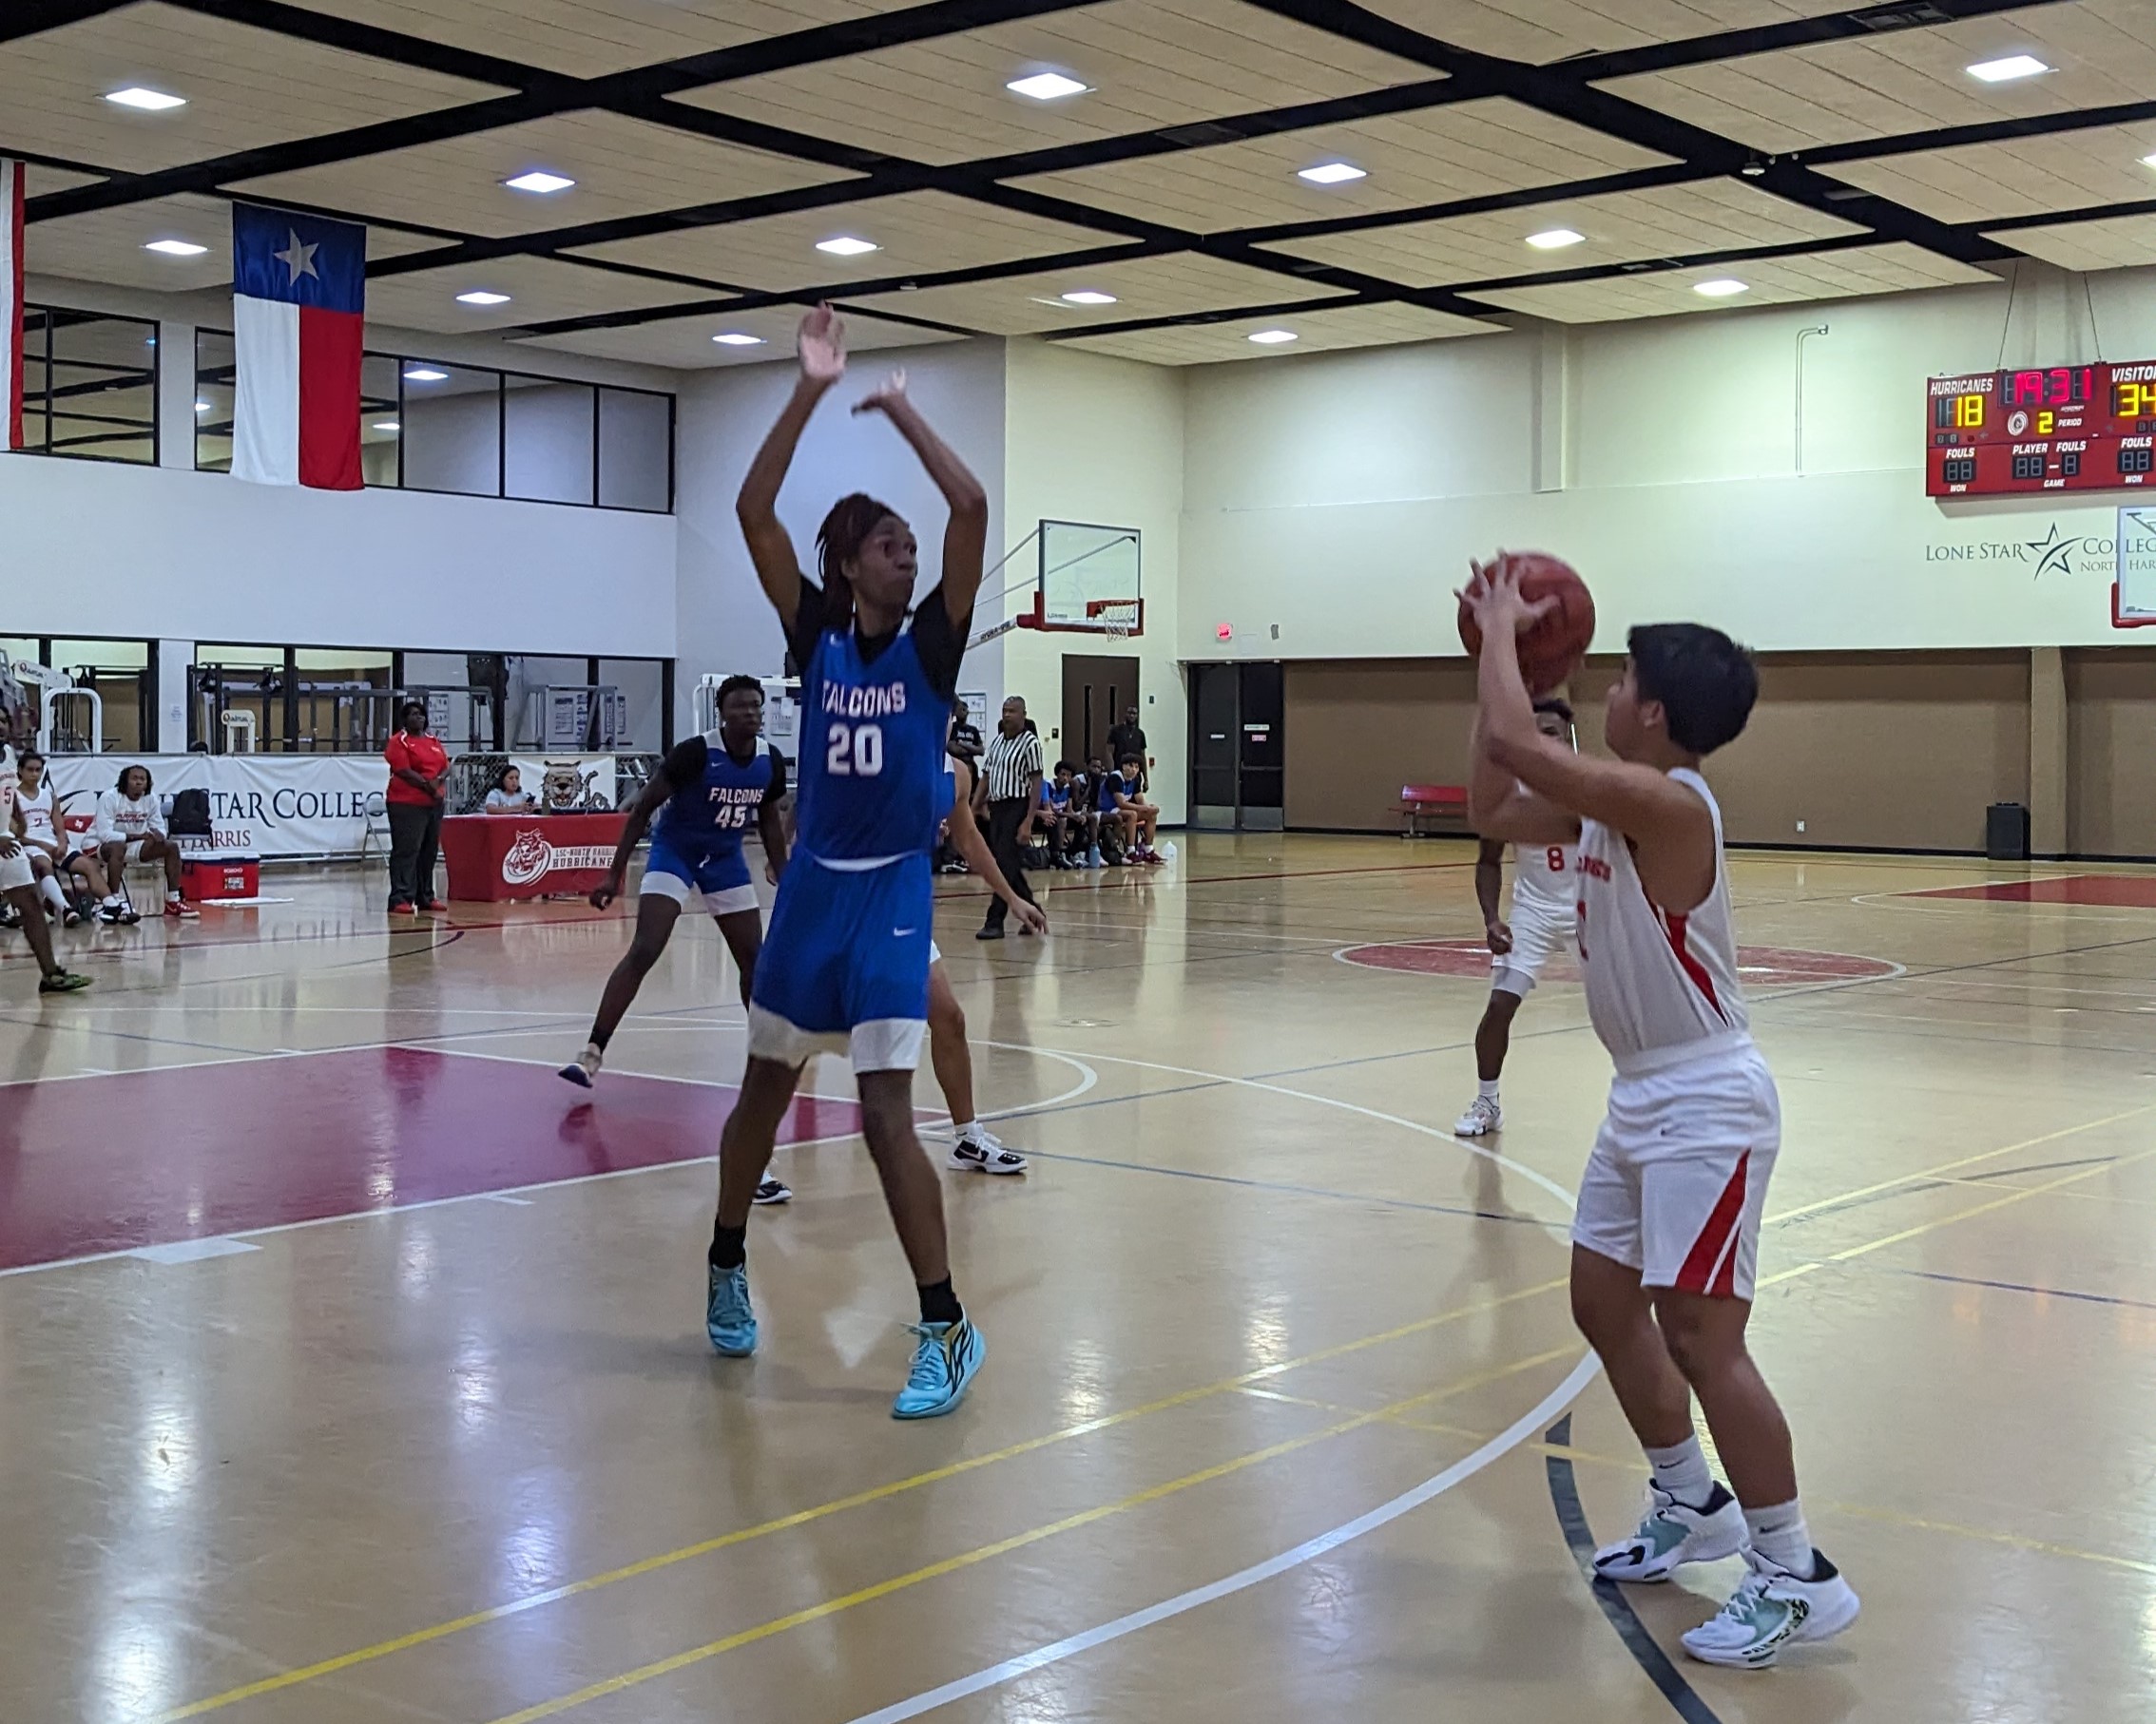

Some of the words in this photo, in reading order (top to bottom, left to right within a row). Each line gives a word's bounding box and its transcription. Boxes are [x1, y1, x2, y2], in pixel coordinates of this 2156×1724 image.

[1930, 377, 1993, 395] HURRICANES
[1957, 394, 1983, 427] 18
[2038, 411, 2053, 434] 2
[2058, 418, 2082, 428] PERIOD
[2012, 443, 2049, 455] PLAYER
[2056, 440, 2087, 452] FOULS
[2121, 436, 2153, 449] FOULS
[1946, 447, 1975, 459] FOULS
[2044, 478, 2066, 488] GAME
[1926, 544, 1974, 562] LONE
[1979, 542, 2030, 563] STAR
[2080, 561, 2118, 572] NORT
[827, 722, 883, 777] 20
[708, 787, 764, 804] FALCONS
[202, 788, 276, 828] TAR
[715, 805, 748, 829] 45
[1547, 847, 1566, 872] 8
